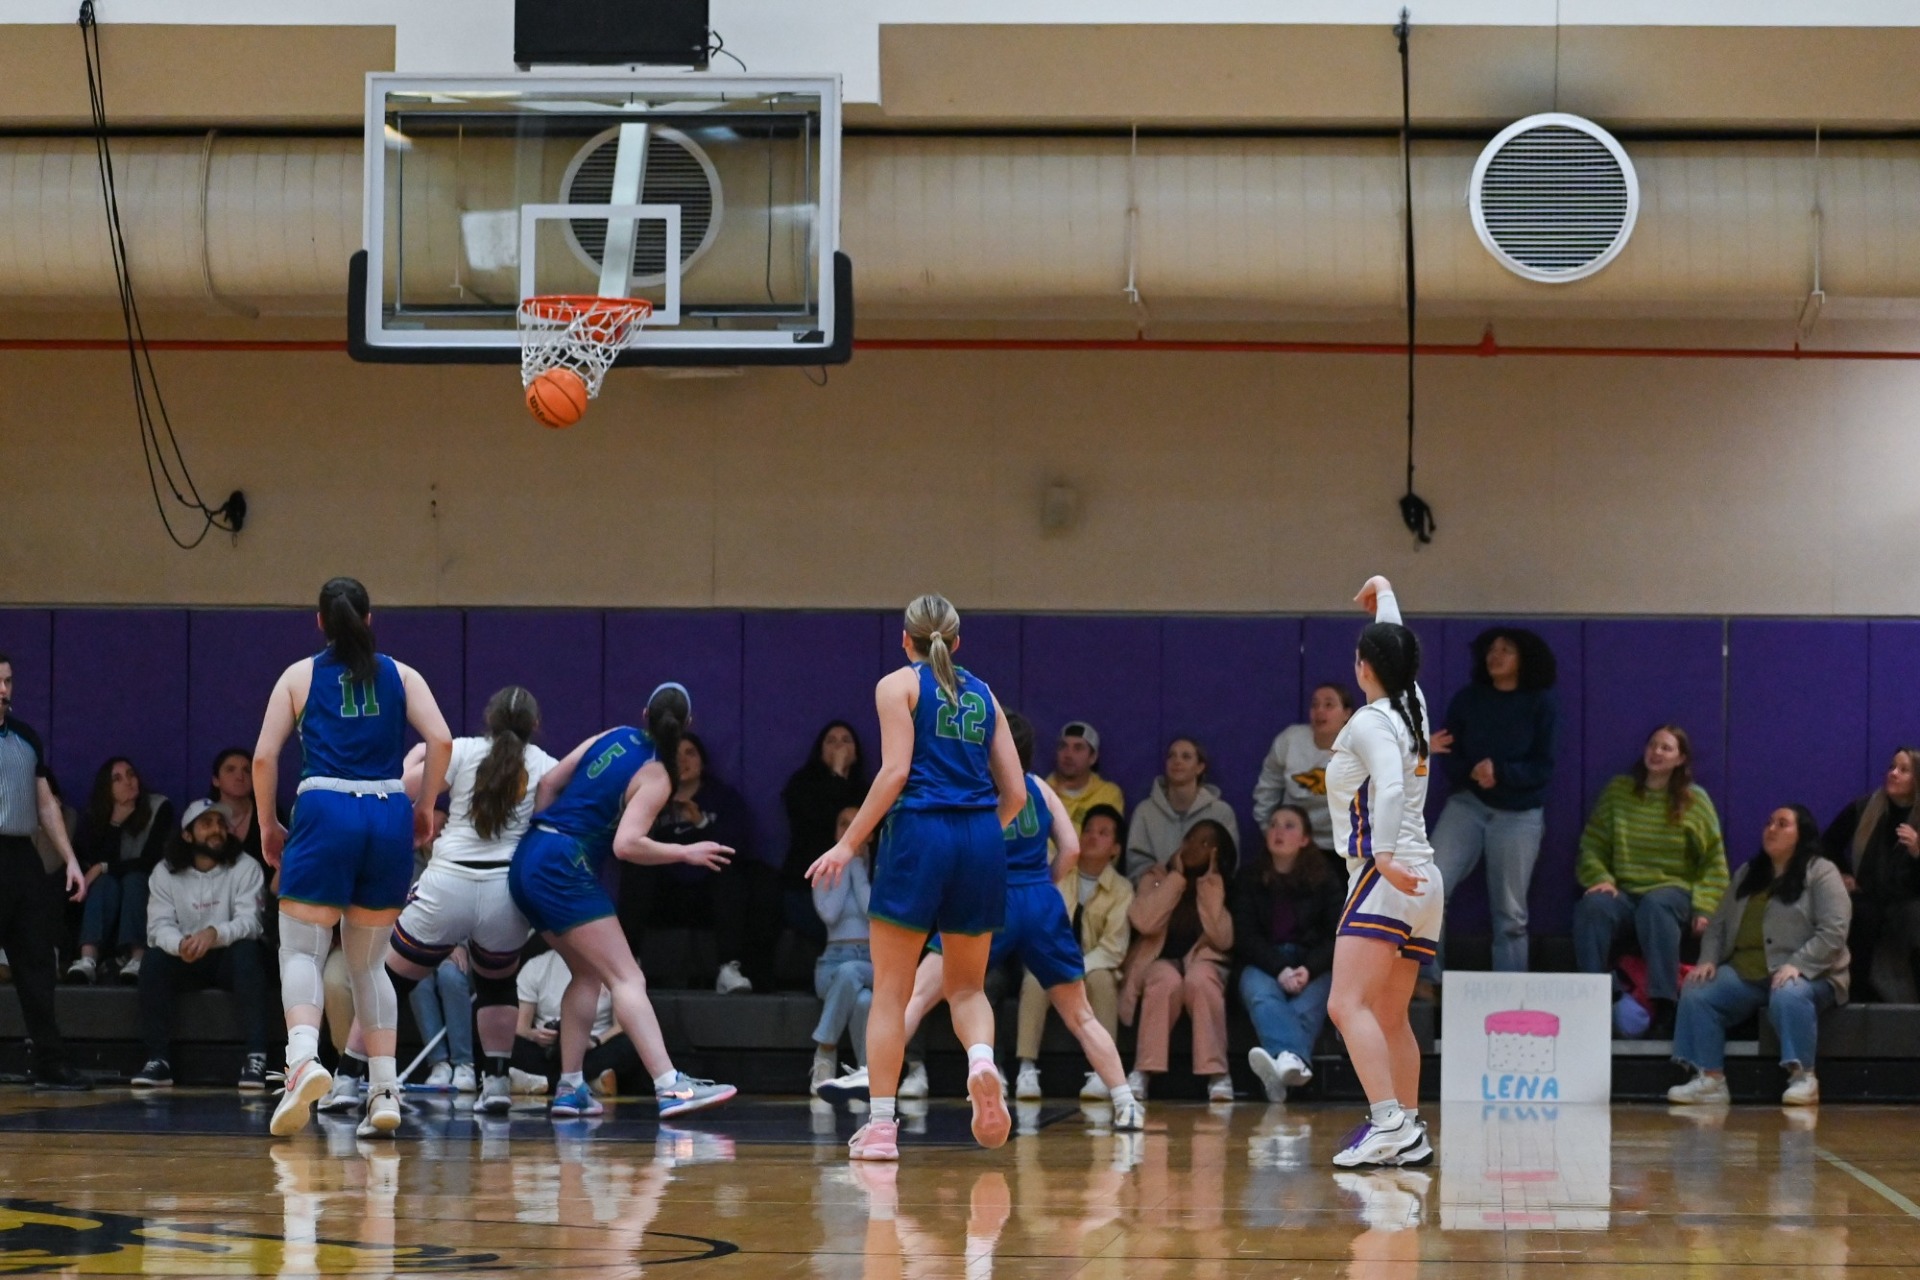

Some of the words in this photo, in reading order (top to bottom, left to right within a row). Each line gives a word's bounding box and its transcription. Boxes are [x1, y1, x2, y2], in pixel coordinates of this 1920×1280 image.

[338, 669, 380, 718] 11
[935, 686, 987, 745] 22
[586, 741, 627, 780] 5
[1482, 1073, 1559, 1101] LENA
